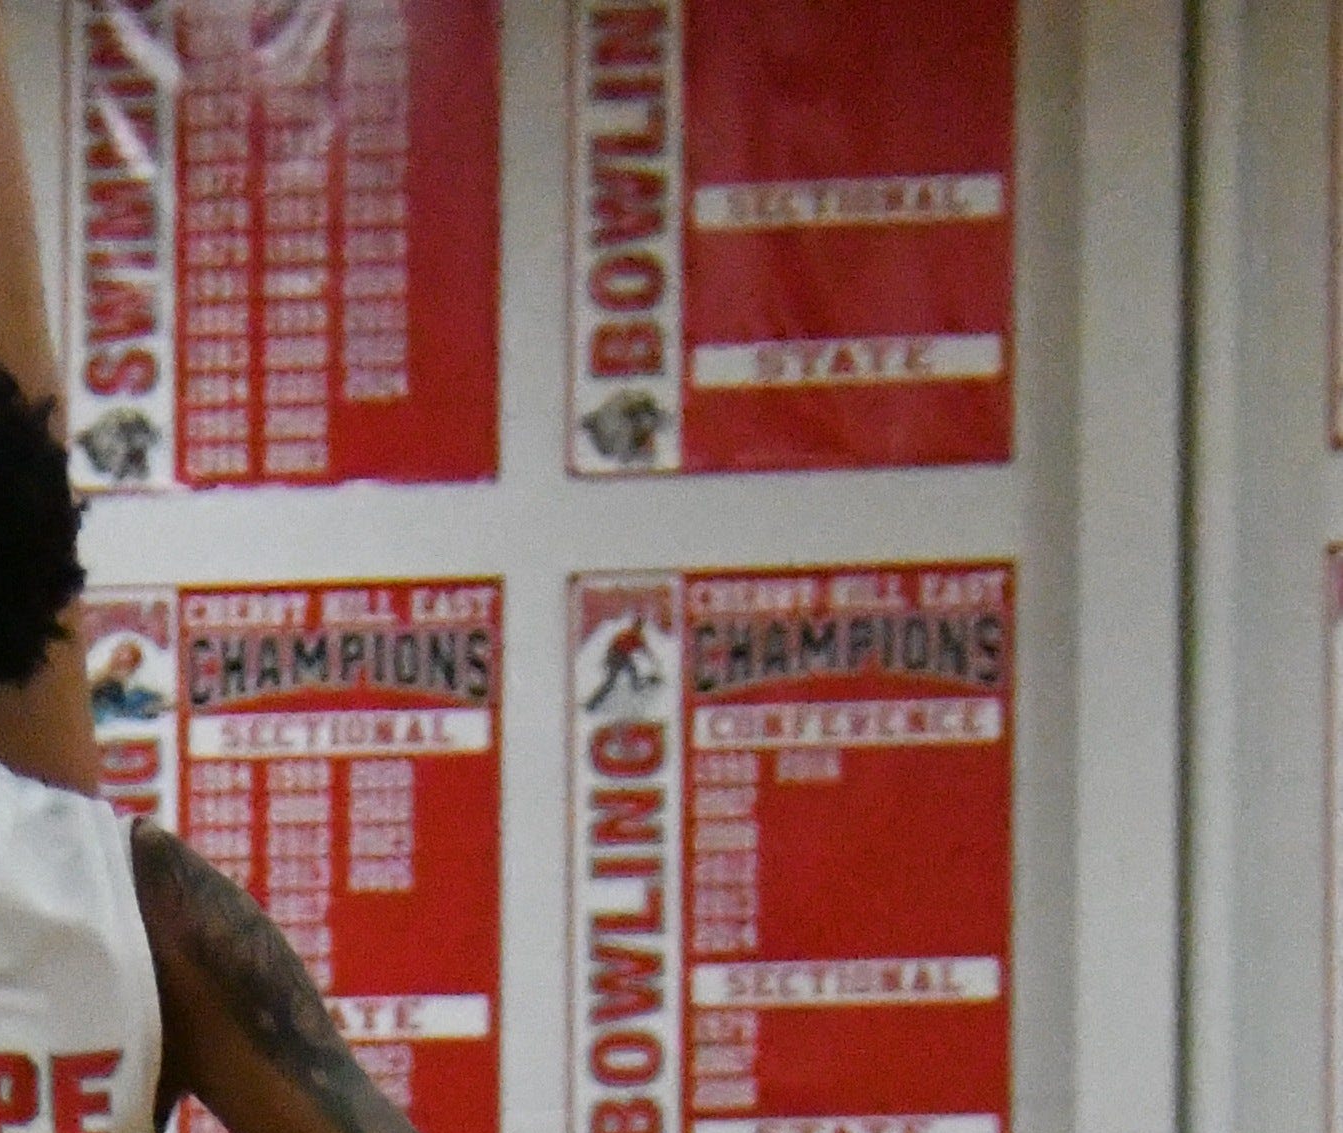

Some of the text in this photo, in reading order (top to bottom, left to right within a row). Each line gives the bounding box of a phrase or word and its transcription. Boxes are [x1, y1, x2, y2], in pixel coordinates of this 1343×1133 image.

[756, 343, 938, 379] STATE
[189, 627, 491, 707] CHAMPIONS
[695, 612, 1002, 692] CHAMPIONS
[219, 711, 452, 748] SECTIONAL
[726, 962, 961, 999] SECTIONAL
